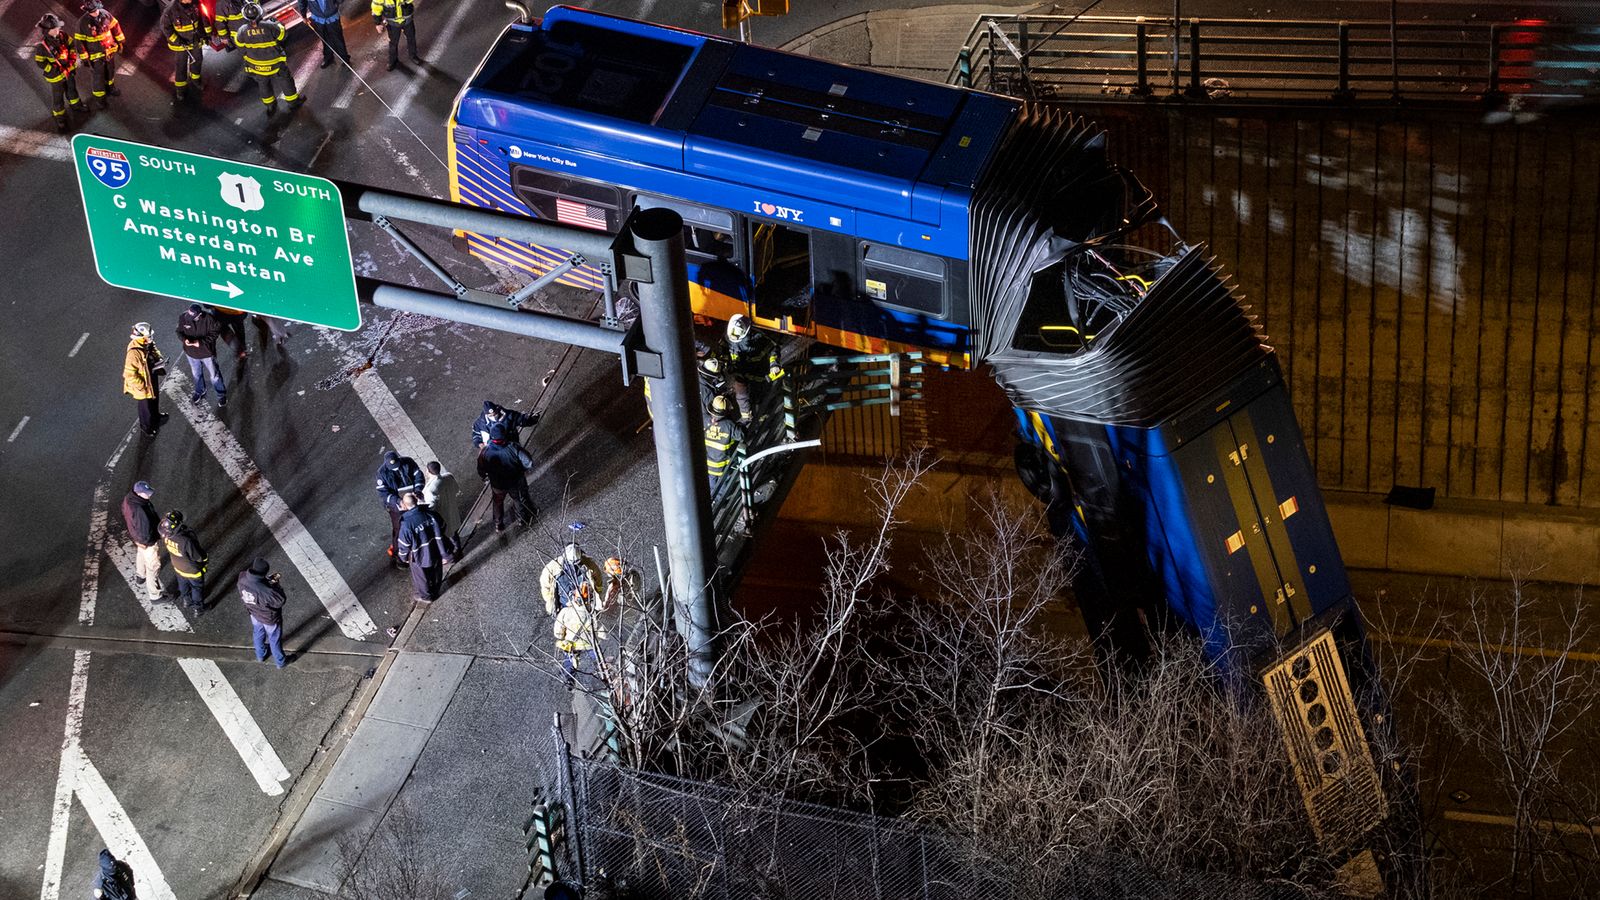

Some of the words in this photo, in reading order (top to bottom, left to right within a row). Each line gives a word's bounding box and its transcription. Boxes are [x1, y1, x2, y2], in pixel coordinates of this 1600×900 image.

[91, 149, 122, 160] INTERSTATE
[523, 151, 536, 159] New
[536, 154, 551, 162] York
[551, 157, 564, 165] City
[564, 159, 577, 167] Bus
[92, 159, 126, 180] 95
[138, 155, 196, 175] SOUTH
[235, 182, 246, 203] 1
[273, 180, 331, 200] SOUTH
[754, 201, 761, 213] I
[113, 194, 127, 209] G
[138, 198, 278, 238] Washington
[289, 227, 316, 245] Br
[123, 217, 257, 256] Amsterdam
[274, 246, 315, 266] Ave
[159, 245, 286, 283] Manhattan
